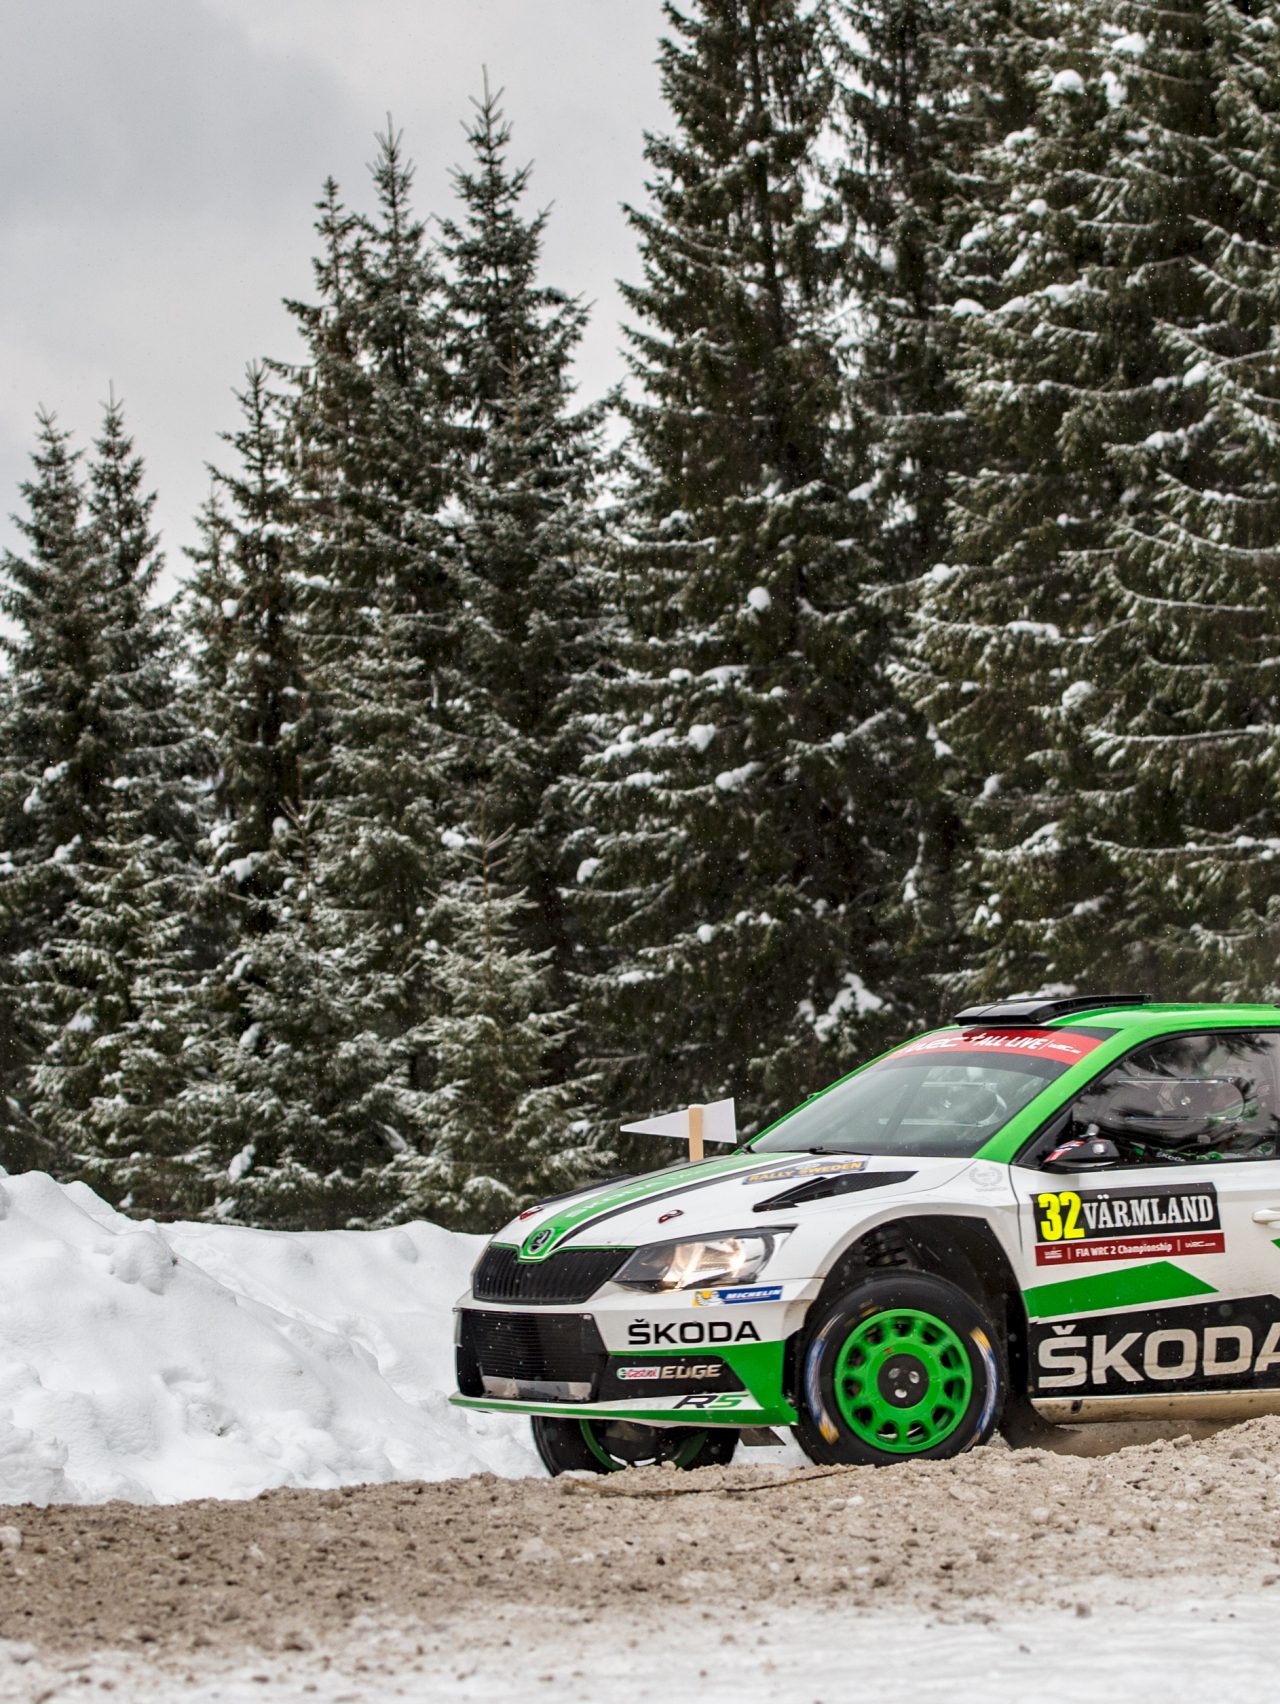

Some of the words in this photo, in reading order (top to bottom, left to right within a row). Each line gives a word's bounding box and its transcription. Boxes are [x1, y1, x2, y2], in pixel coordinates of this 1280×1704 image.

[1004, 1035, 1048, 1051] LIVE
[750, 1170, 794, 1182] RALLY
[798, 1161, 863, 1175] SWEDEN
[1037, 1191, 1086, 1241] 32
[1081, 1194, 1214, 1231] VÄRMLAND
[1075, 1246, 1091, 1258] FIA
[1090, 1245, 1110, 1257] WRC
[1110, 1244, 1117, 1255] 2
[1117, 1241, 1173, 1255] Championship
[725, 1288, 782, 1300] MICHELIN
[628, 1319, 761, 1345] ŠKODA
[672, 1394, 750, 1409] R5
